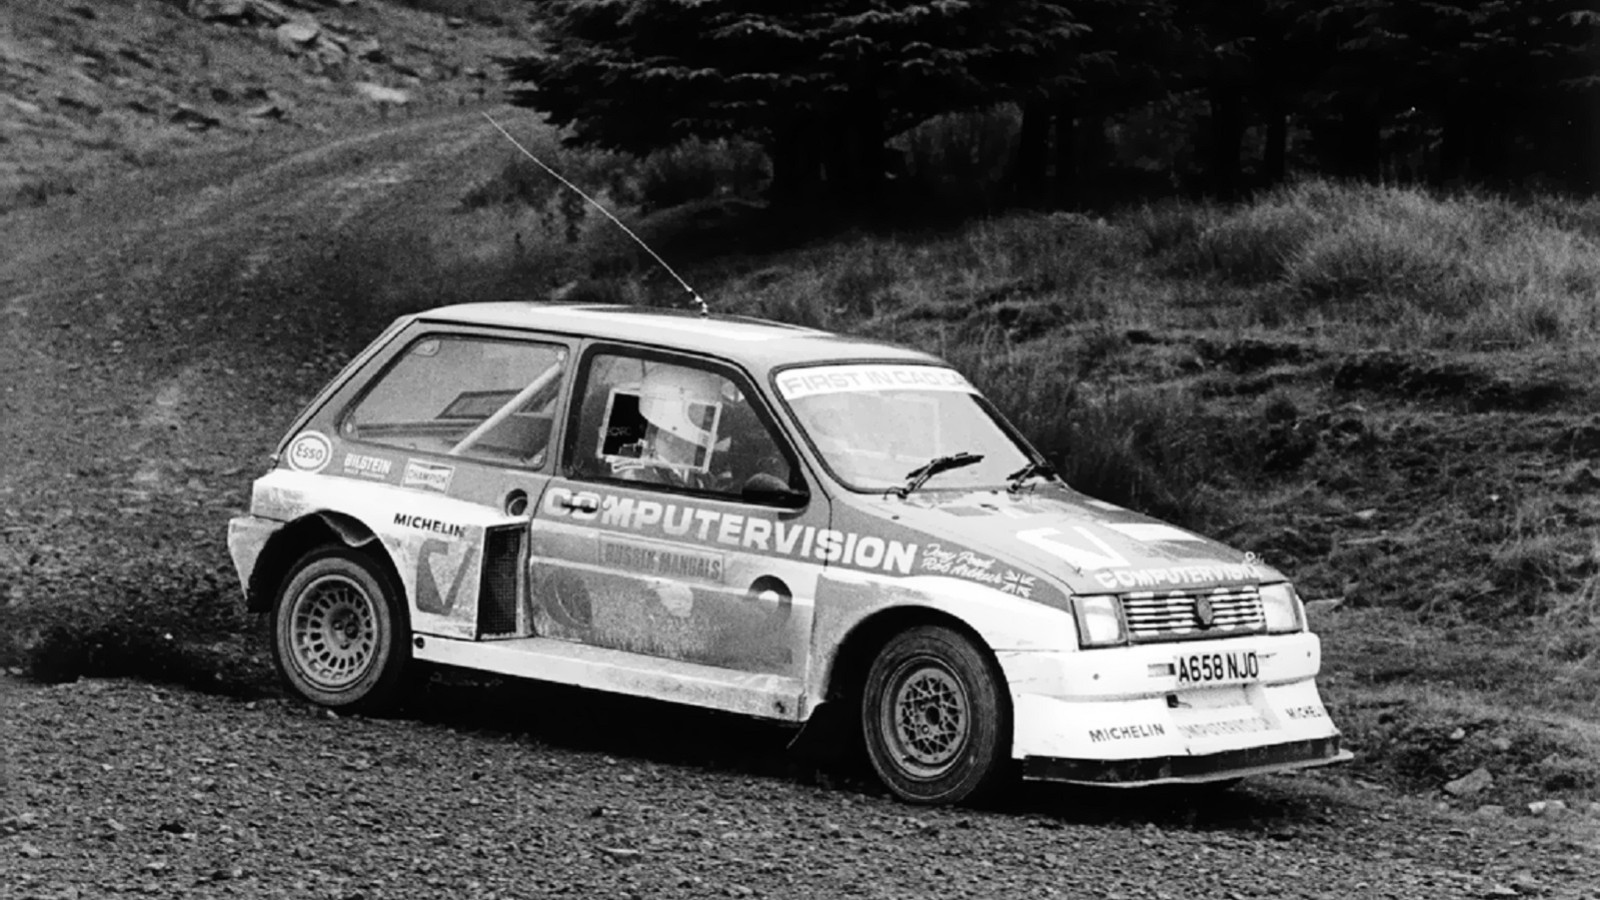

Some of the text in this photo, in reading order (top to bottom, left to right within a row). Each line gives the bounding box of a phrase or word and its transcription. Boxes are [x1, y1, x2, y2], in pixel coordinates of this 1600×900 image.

[781, 372, 860, 395] FIRST
[864, 370, 890, 386] IN
[344, 453, 392, 475] BILSTEIN
[393, 513, 465, 537] MICHELIN
[544, 487, 918, 574] COMPUTERVISION
[1094, 564, 1263, 588] COMPUTERVISION
[1179, 651, 1259, 682] A658 NJO
[1088, 723, 1166, 743] MICHELIN
